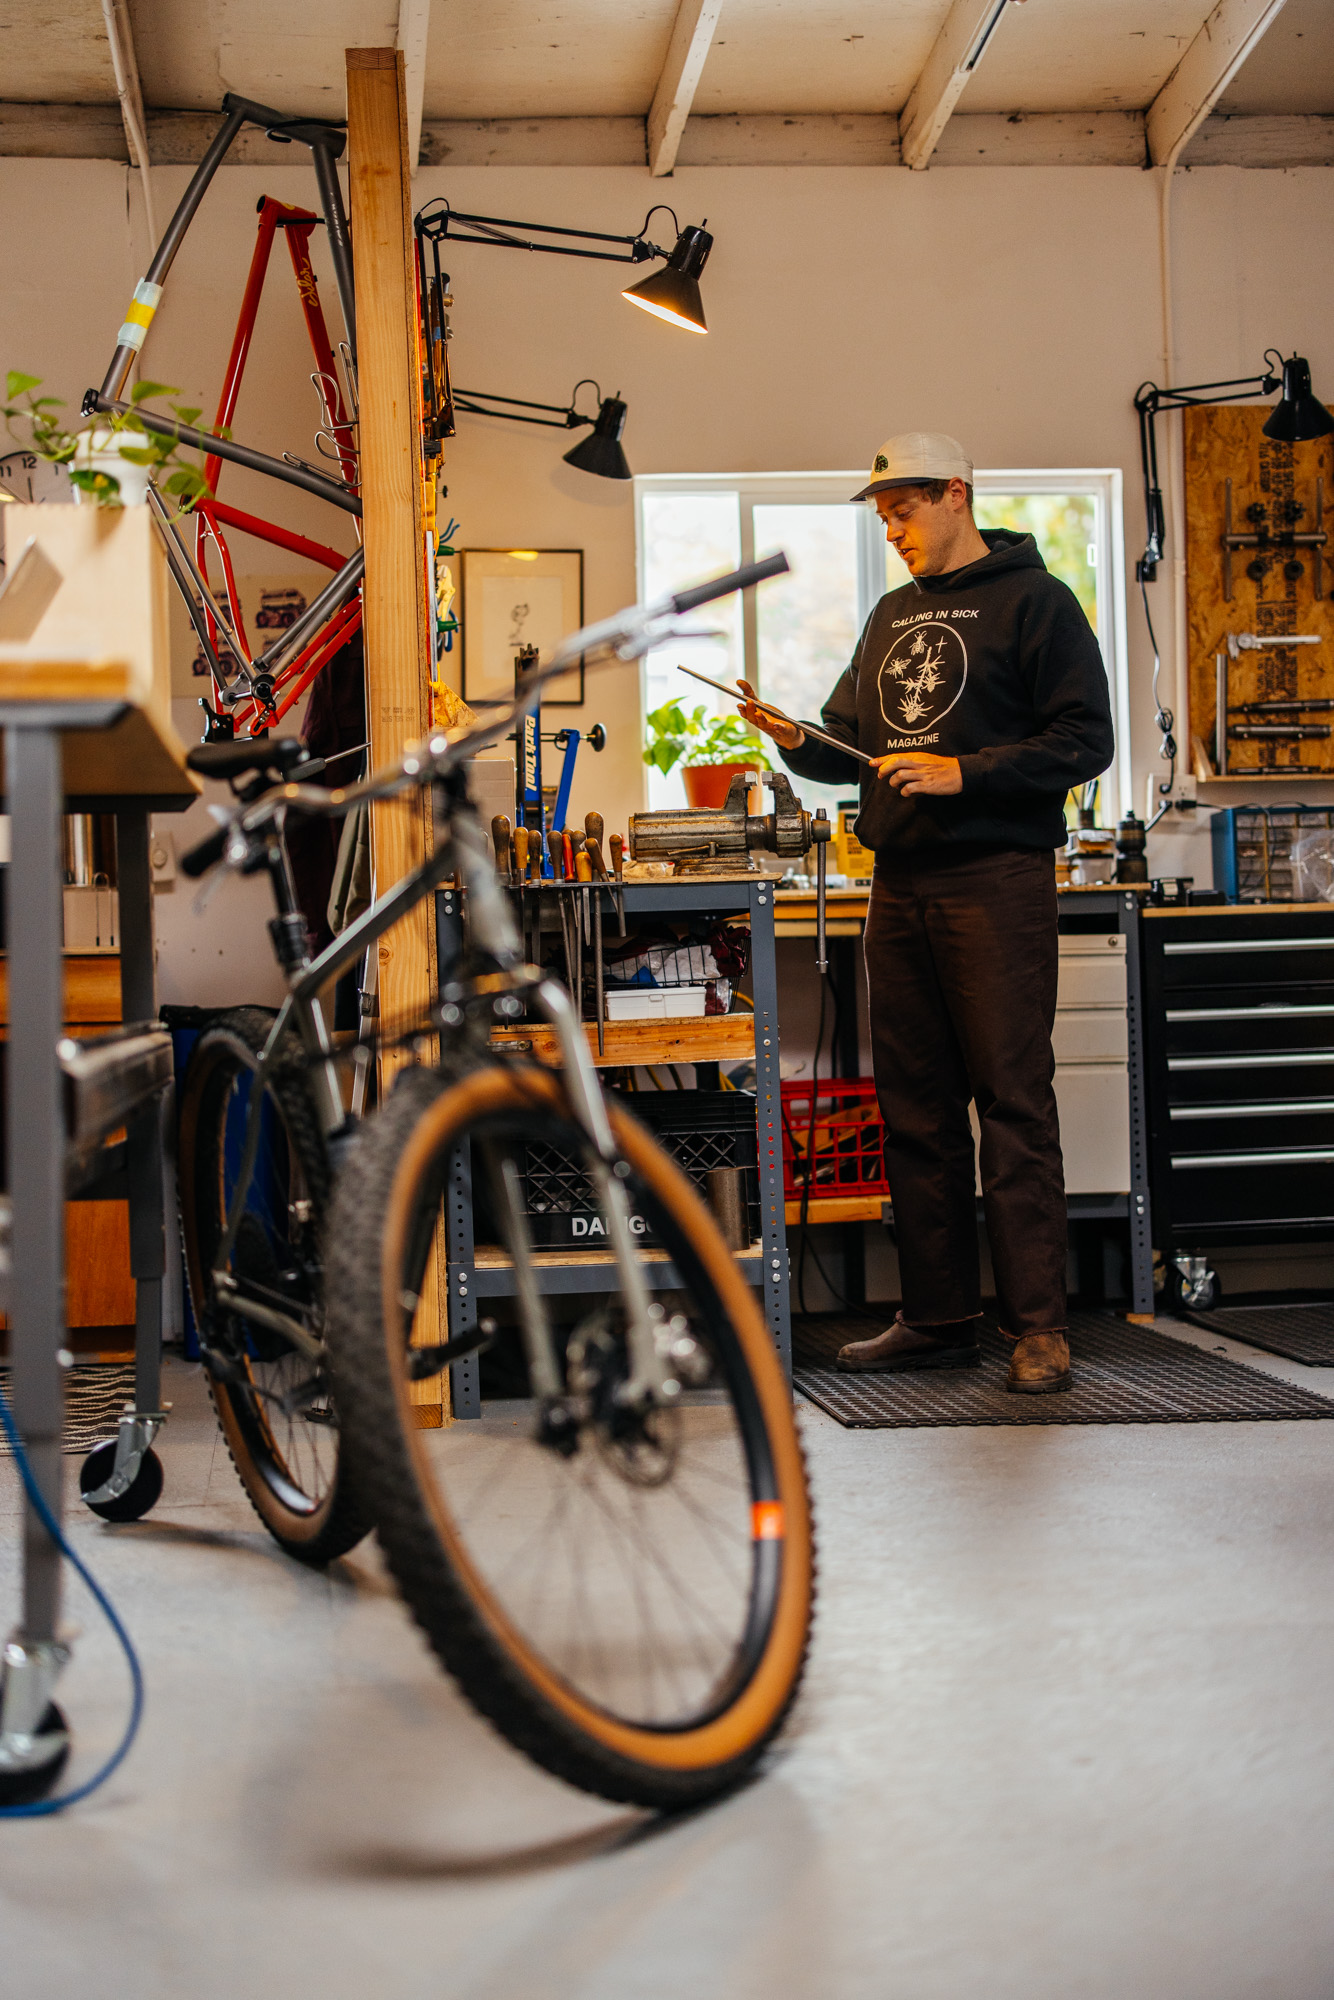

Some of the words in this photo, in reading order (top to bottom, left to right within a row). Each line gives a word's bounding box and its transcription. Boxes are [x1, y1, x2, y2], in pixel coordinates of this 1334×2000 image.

[22, 456, 37, 469] 12
[0, 465, 12, 477] 11
[891, 611, 933, 628] CALLING
[935, 610, 949, 619] IN
[951, 609, 980, 619] SICK
[887, 732, 939, 748] MAGAZINE
